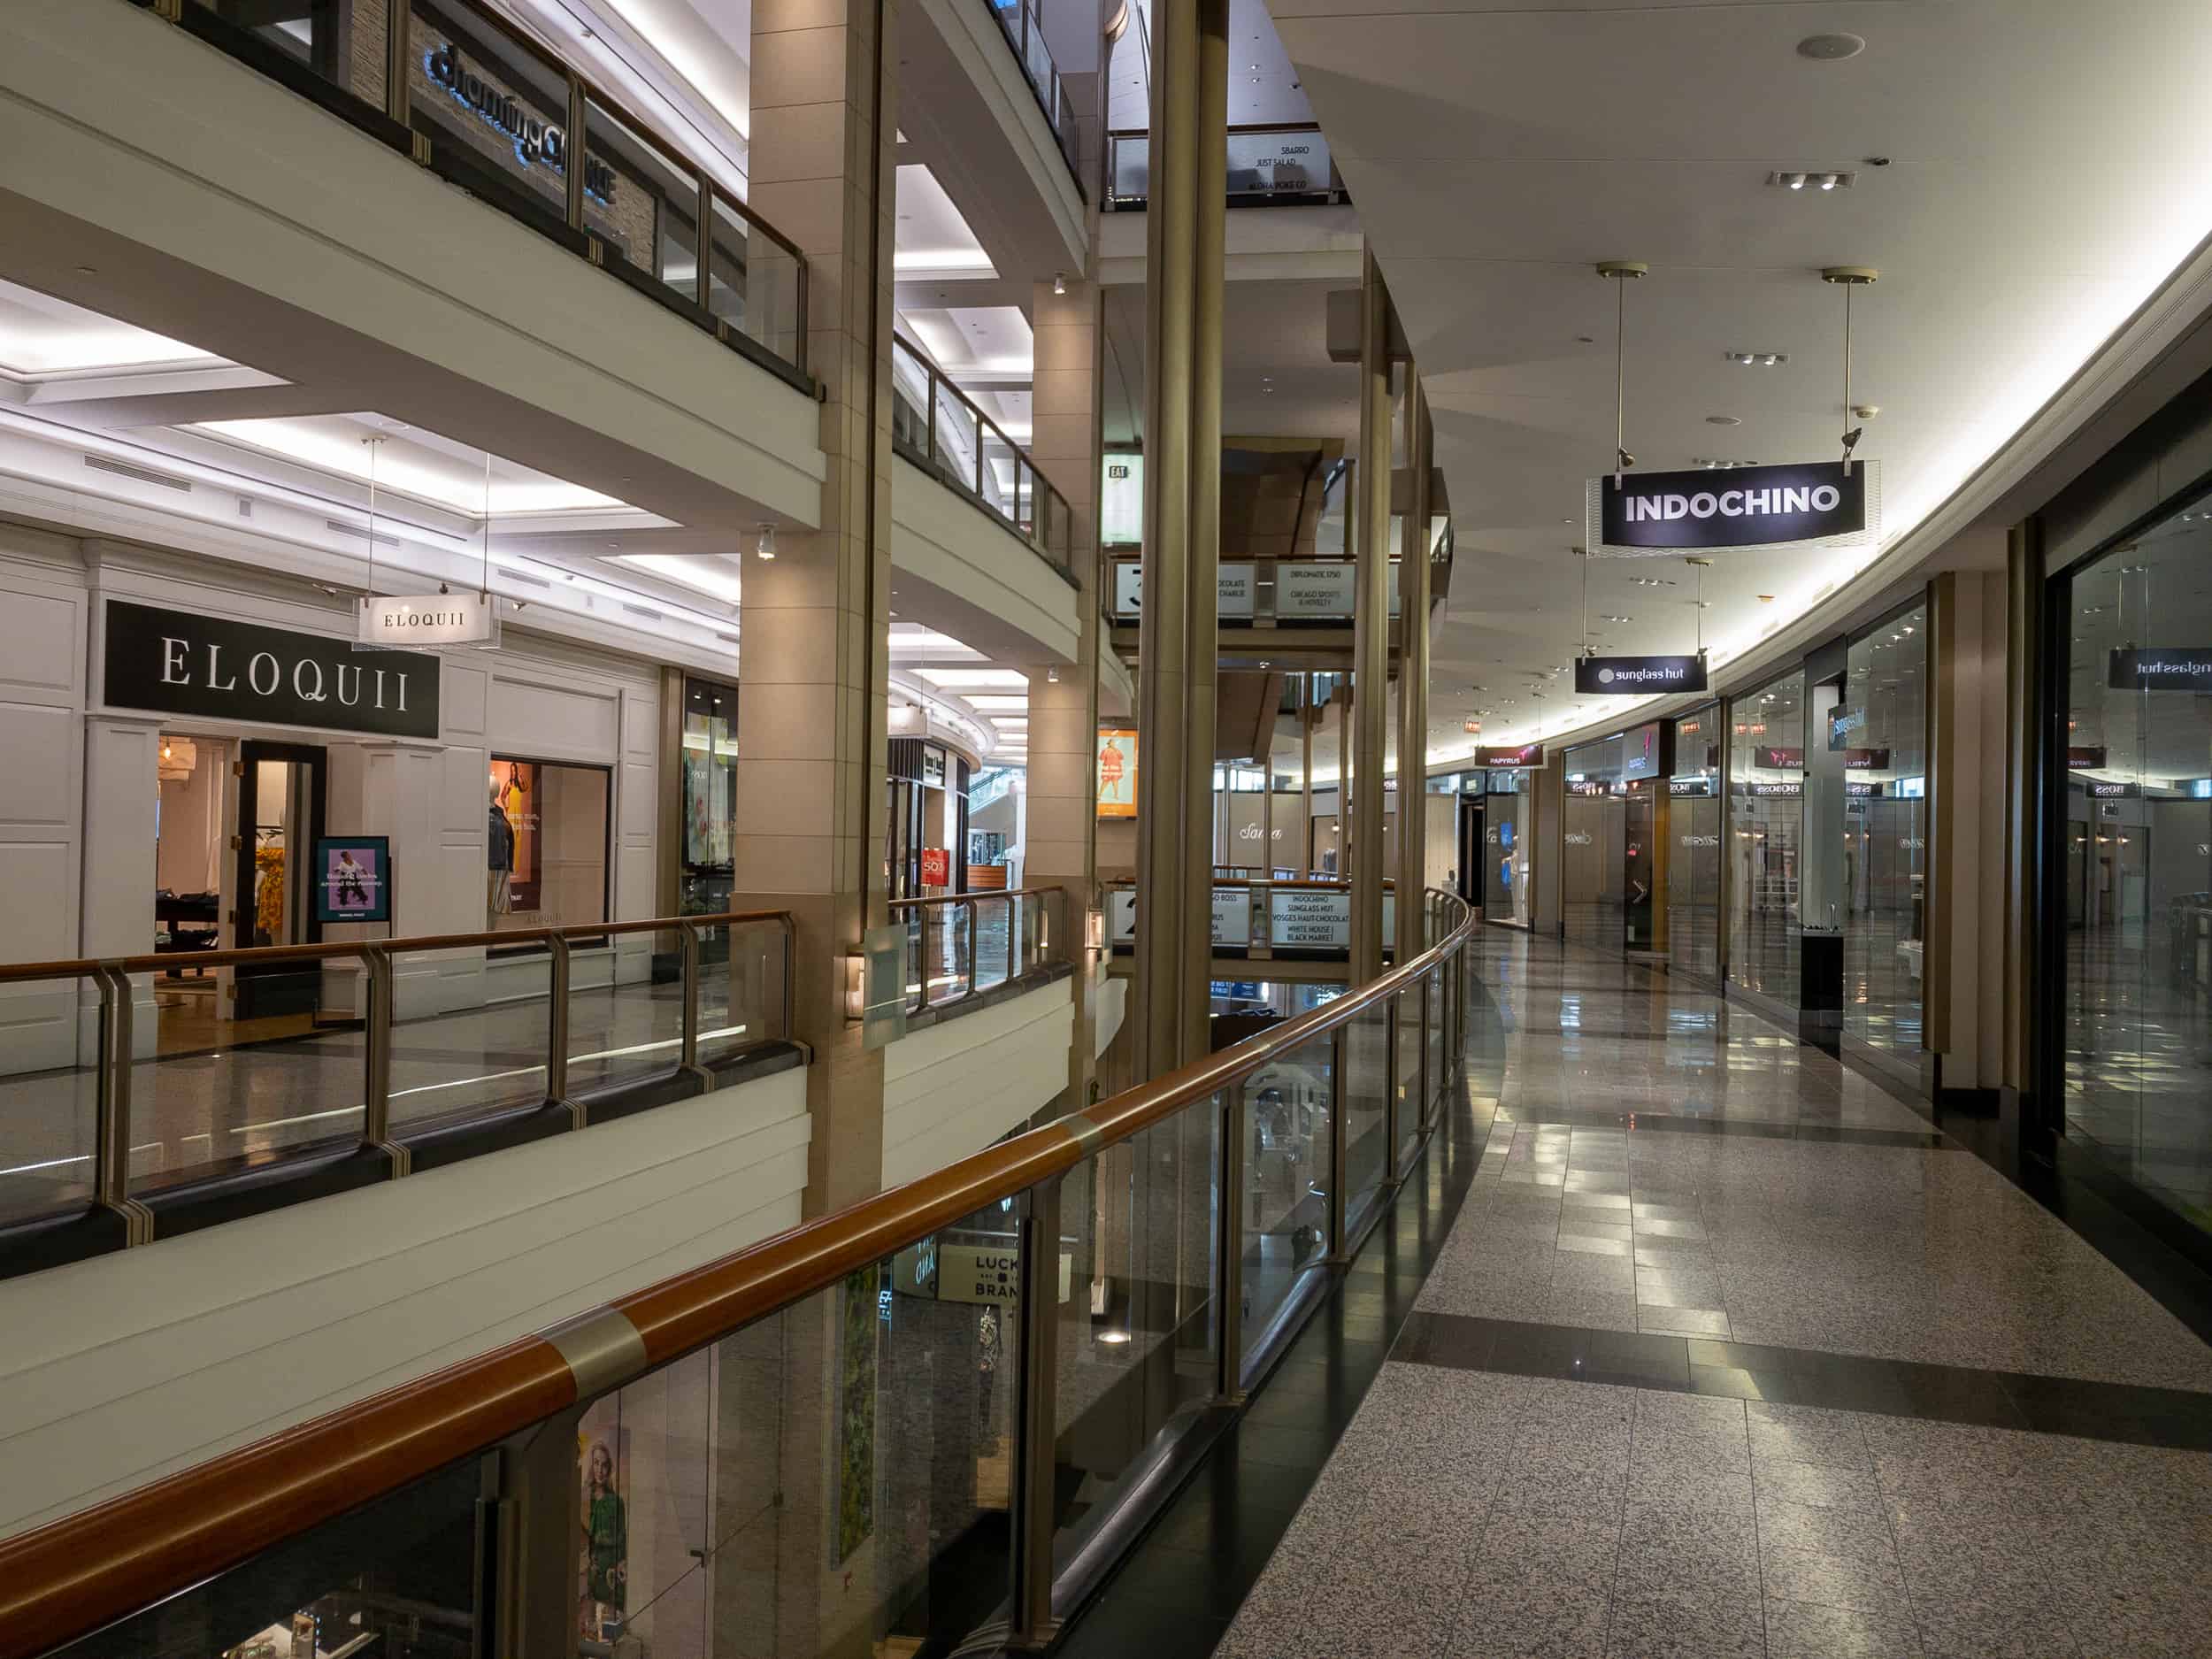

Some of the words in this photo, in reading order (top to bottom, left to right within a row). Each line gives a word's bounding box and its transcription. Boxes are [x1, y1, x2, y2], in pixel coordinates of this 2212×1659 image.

[1281, 146, 1310, 155] SBARRO
[1256, 158, 1272, 167] JUST
[1274, 158, 1296, 167] SALAD
[1626, 485, 1840, 522] INDOCHINO
[384, 612, 465, 627] ELOQUII
[159, 636, 410, 712] ELOQUII
[1616, 669, 1663, 682] sunglass
[1665, 667, 1684, 680] hut
[976, 1256, 1018, 1271] LUCK
[975, 1283, 1018, 1298] BRAN
